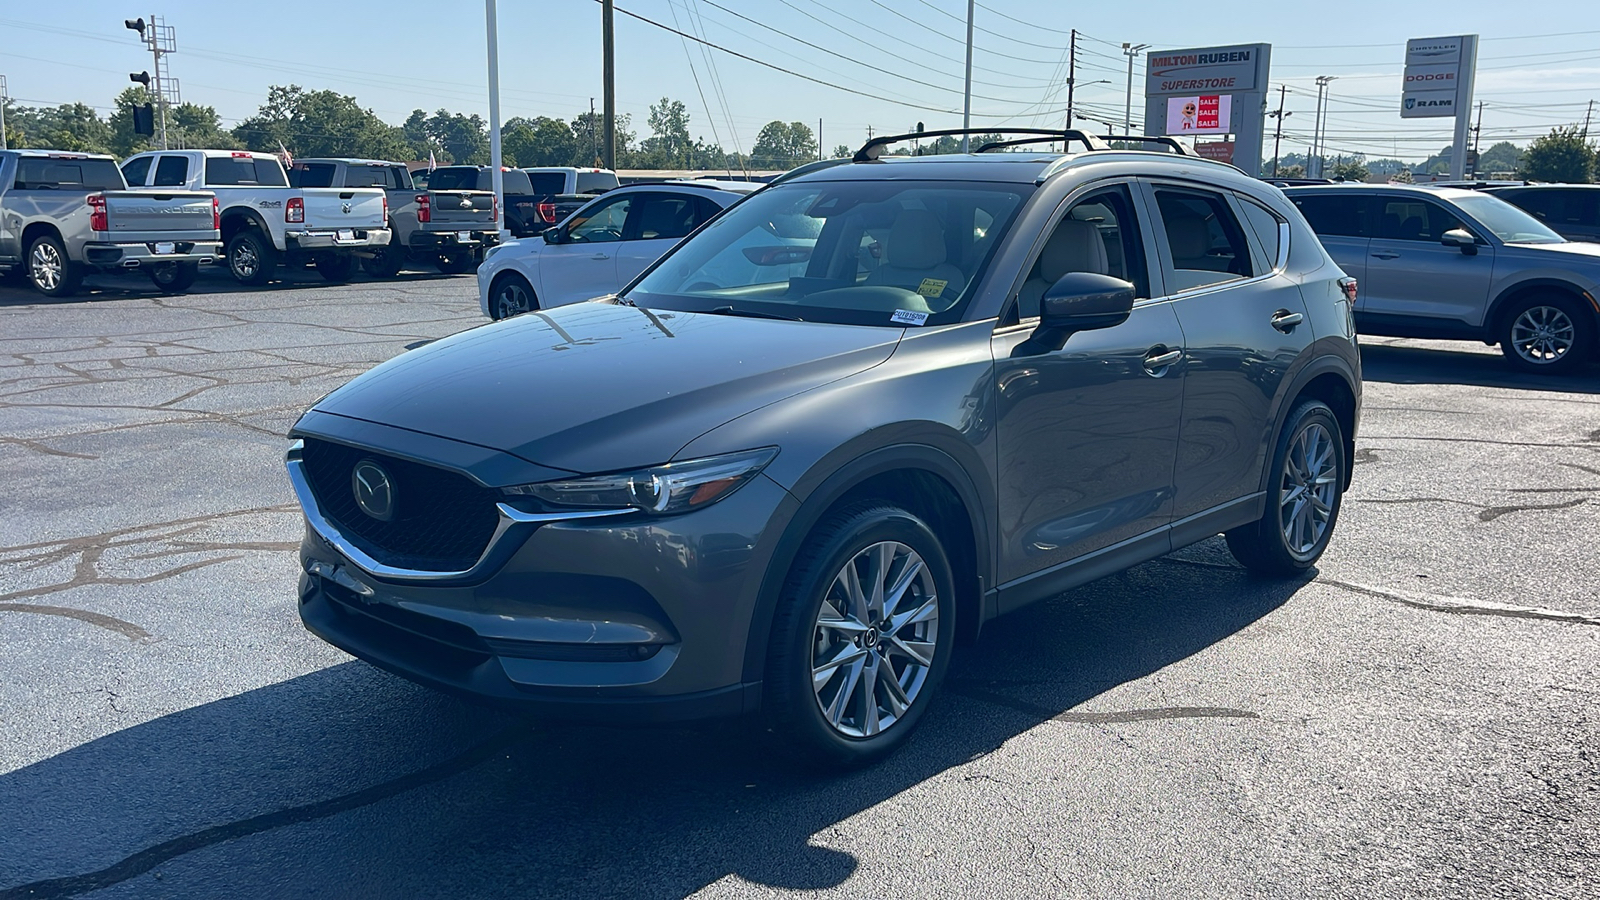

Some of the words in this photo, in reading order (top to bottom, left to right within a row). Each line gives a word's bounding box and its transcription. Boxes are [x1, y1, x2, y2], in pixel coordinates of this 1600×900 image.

[1406, 73, 1454, 82] DODGE
[1161, 77, 1236, 90] SUPERSTORE
[115, 206, 210, 214] CHEVROLET
